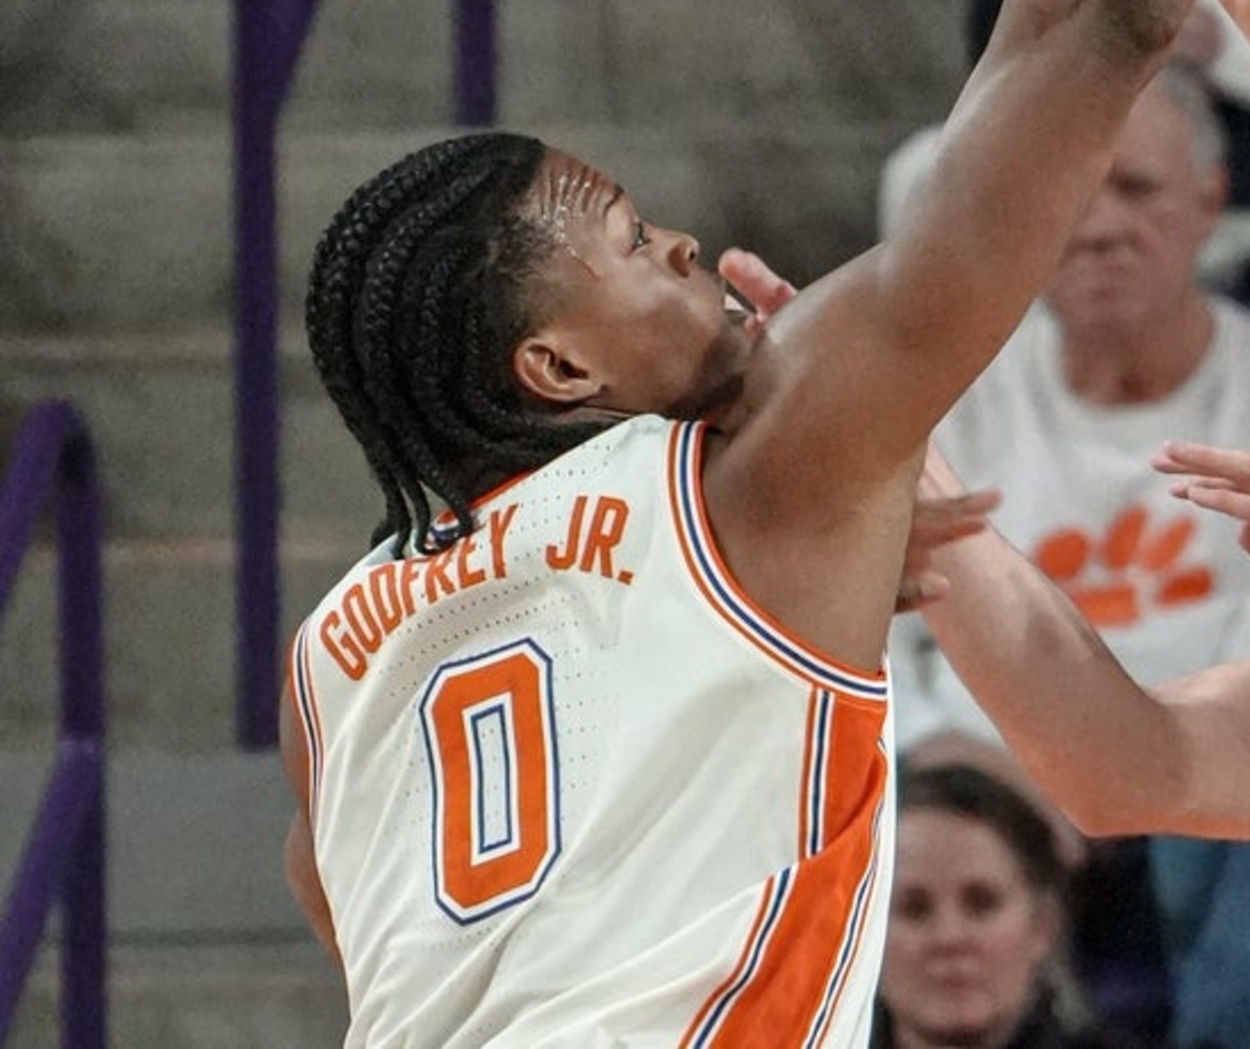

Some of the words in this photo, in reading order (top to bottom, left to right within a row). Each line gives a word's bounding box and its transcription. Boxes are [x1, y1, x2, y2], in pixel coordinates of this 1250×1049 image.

[319, 504, 518, 681] GODFREY
[545, 495, 635, 586] JR.
[419, 637, 562, 927] 0
